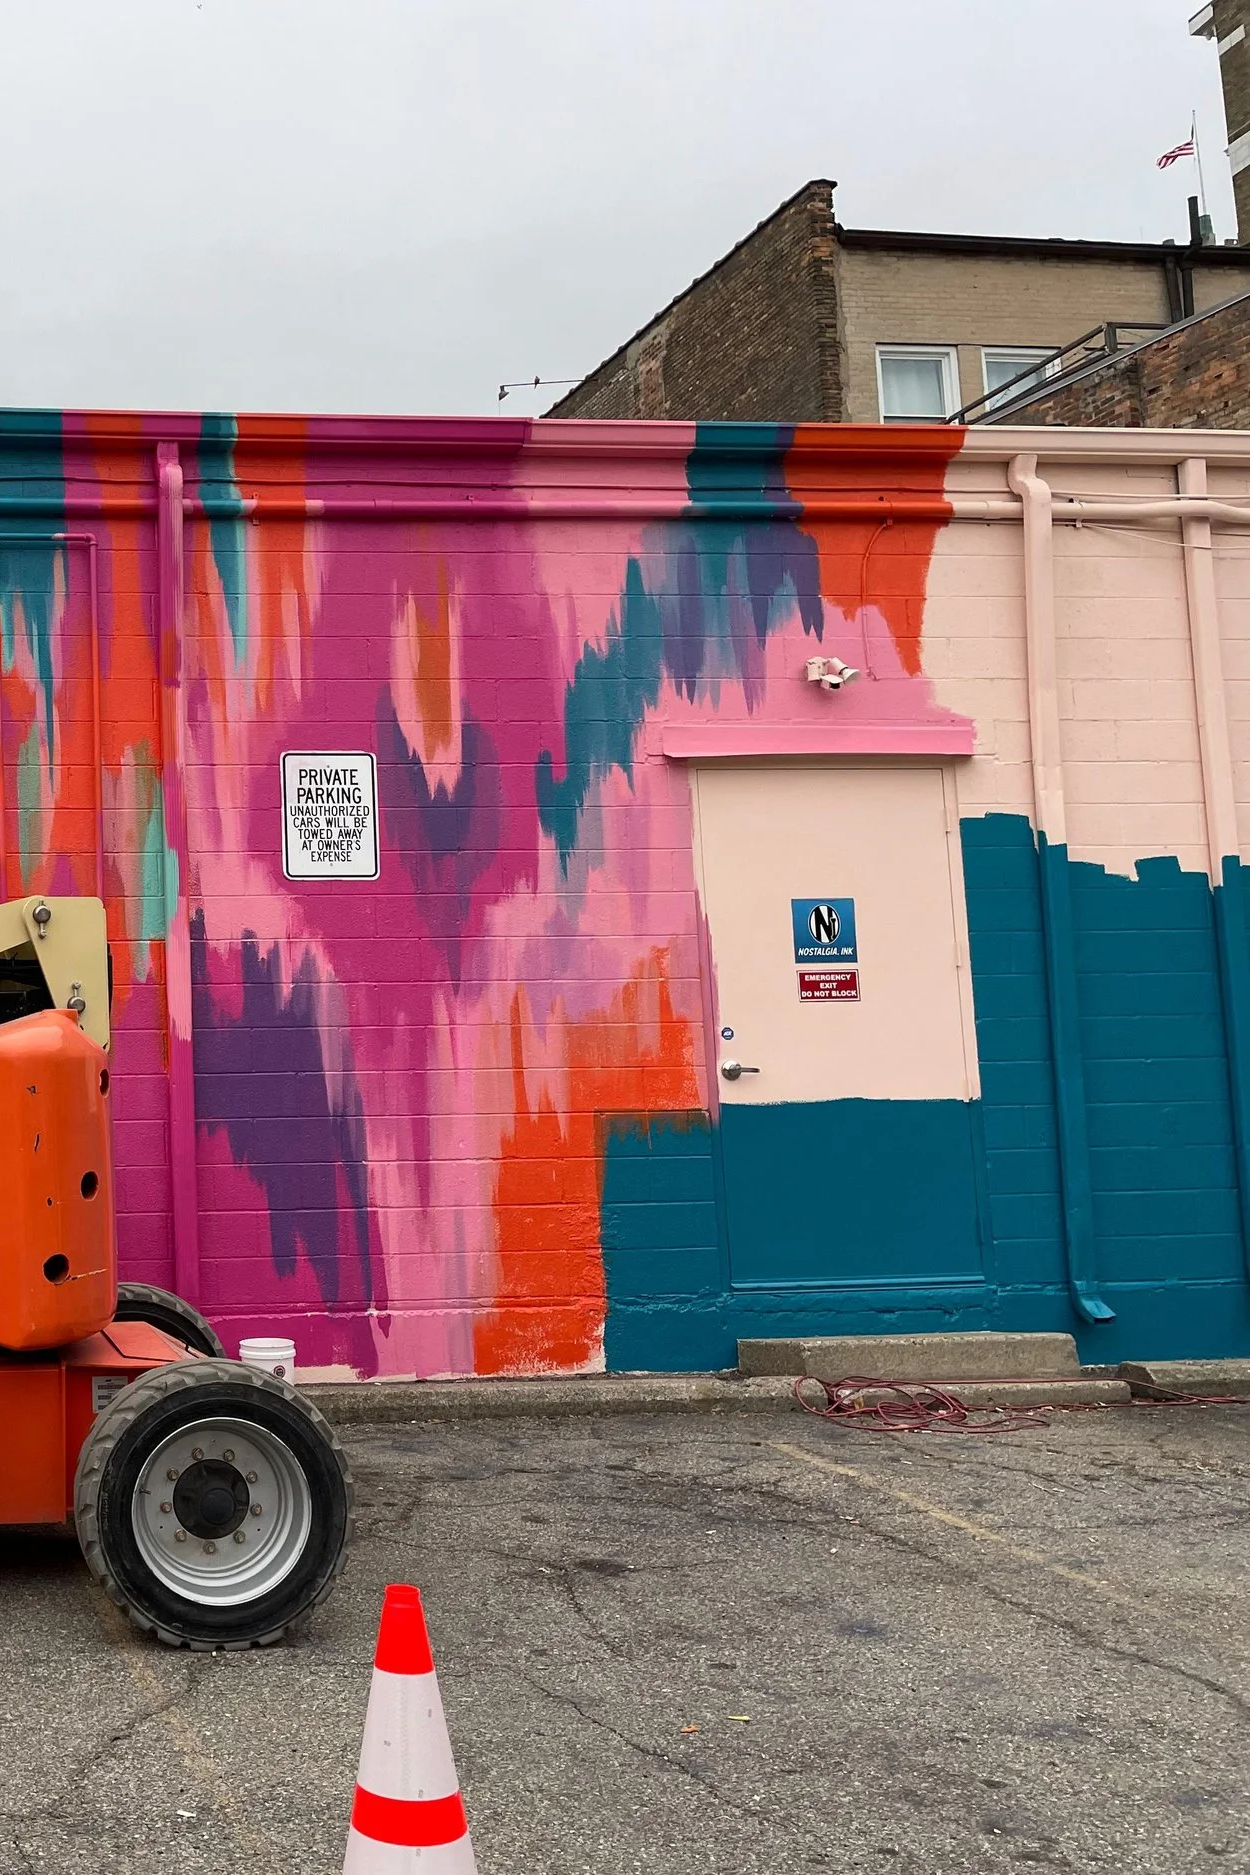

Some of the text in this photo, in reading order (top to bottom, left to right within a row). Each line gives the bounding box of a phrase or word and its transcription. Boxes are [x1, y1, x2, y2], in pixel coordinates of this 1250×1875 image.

[299, 769, 358, 785] PRIVATE
[297, 787, 362, 804] PARKING
[290, 805, 370, 816] UNAUTHORIZED
[293, 817, 368, 828] CARS WILL BE
[298, 828, 364, 840] TOWED AWAY
[301, 840, 361, 851] AT OWNER'S
[311, 851, 352, 862] EXPENSE
[840, 947, 854, 955] INK
